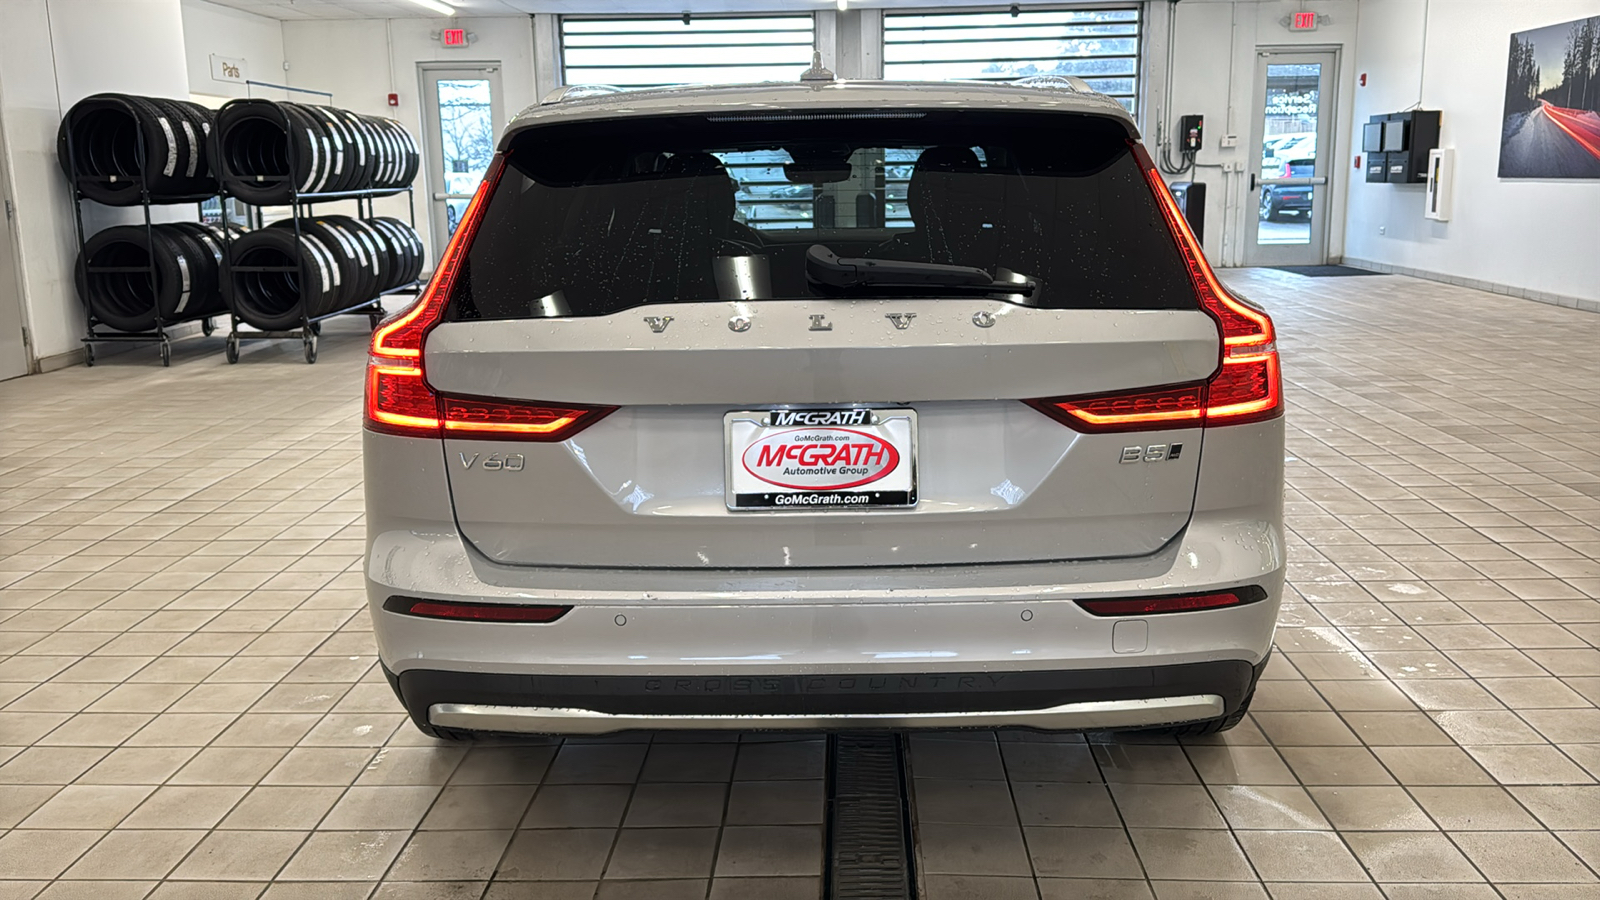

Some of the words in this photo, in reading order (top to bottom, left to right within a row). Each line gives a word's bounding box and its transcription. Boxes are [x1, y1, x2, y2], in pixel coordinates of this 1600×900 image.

[1295, 12, 1315, 28] EXIT
[444, 29, 463, 45] EXIT
[222, 62, 240, 78] Parts
[644, 310, 996, 333] VOLVO
[459, 452, 525, 471] V60
[783, 467, 837, 476] Automotive
[839, 467, 869, 476] Group
[775, 494, 869, 505] GoMcGrath.com
[805, 674, 1006, 692] COUNTRY
